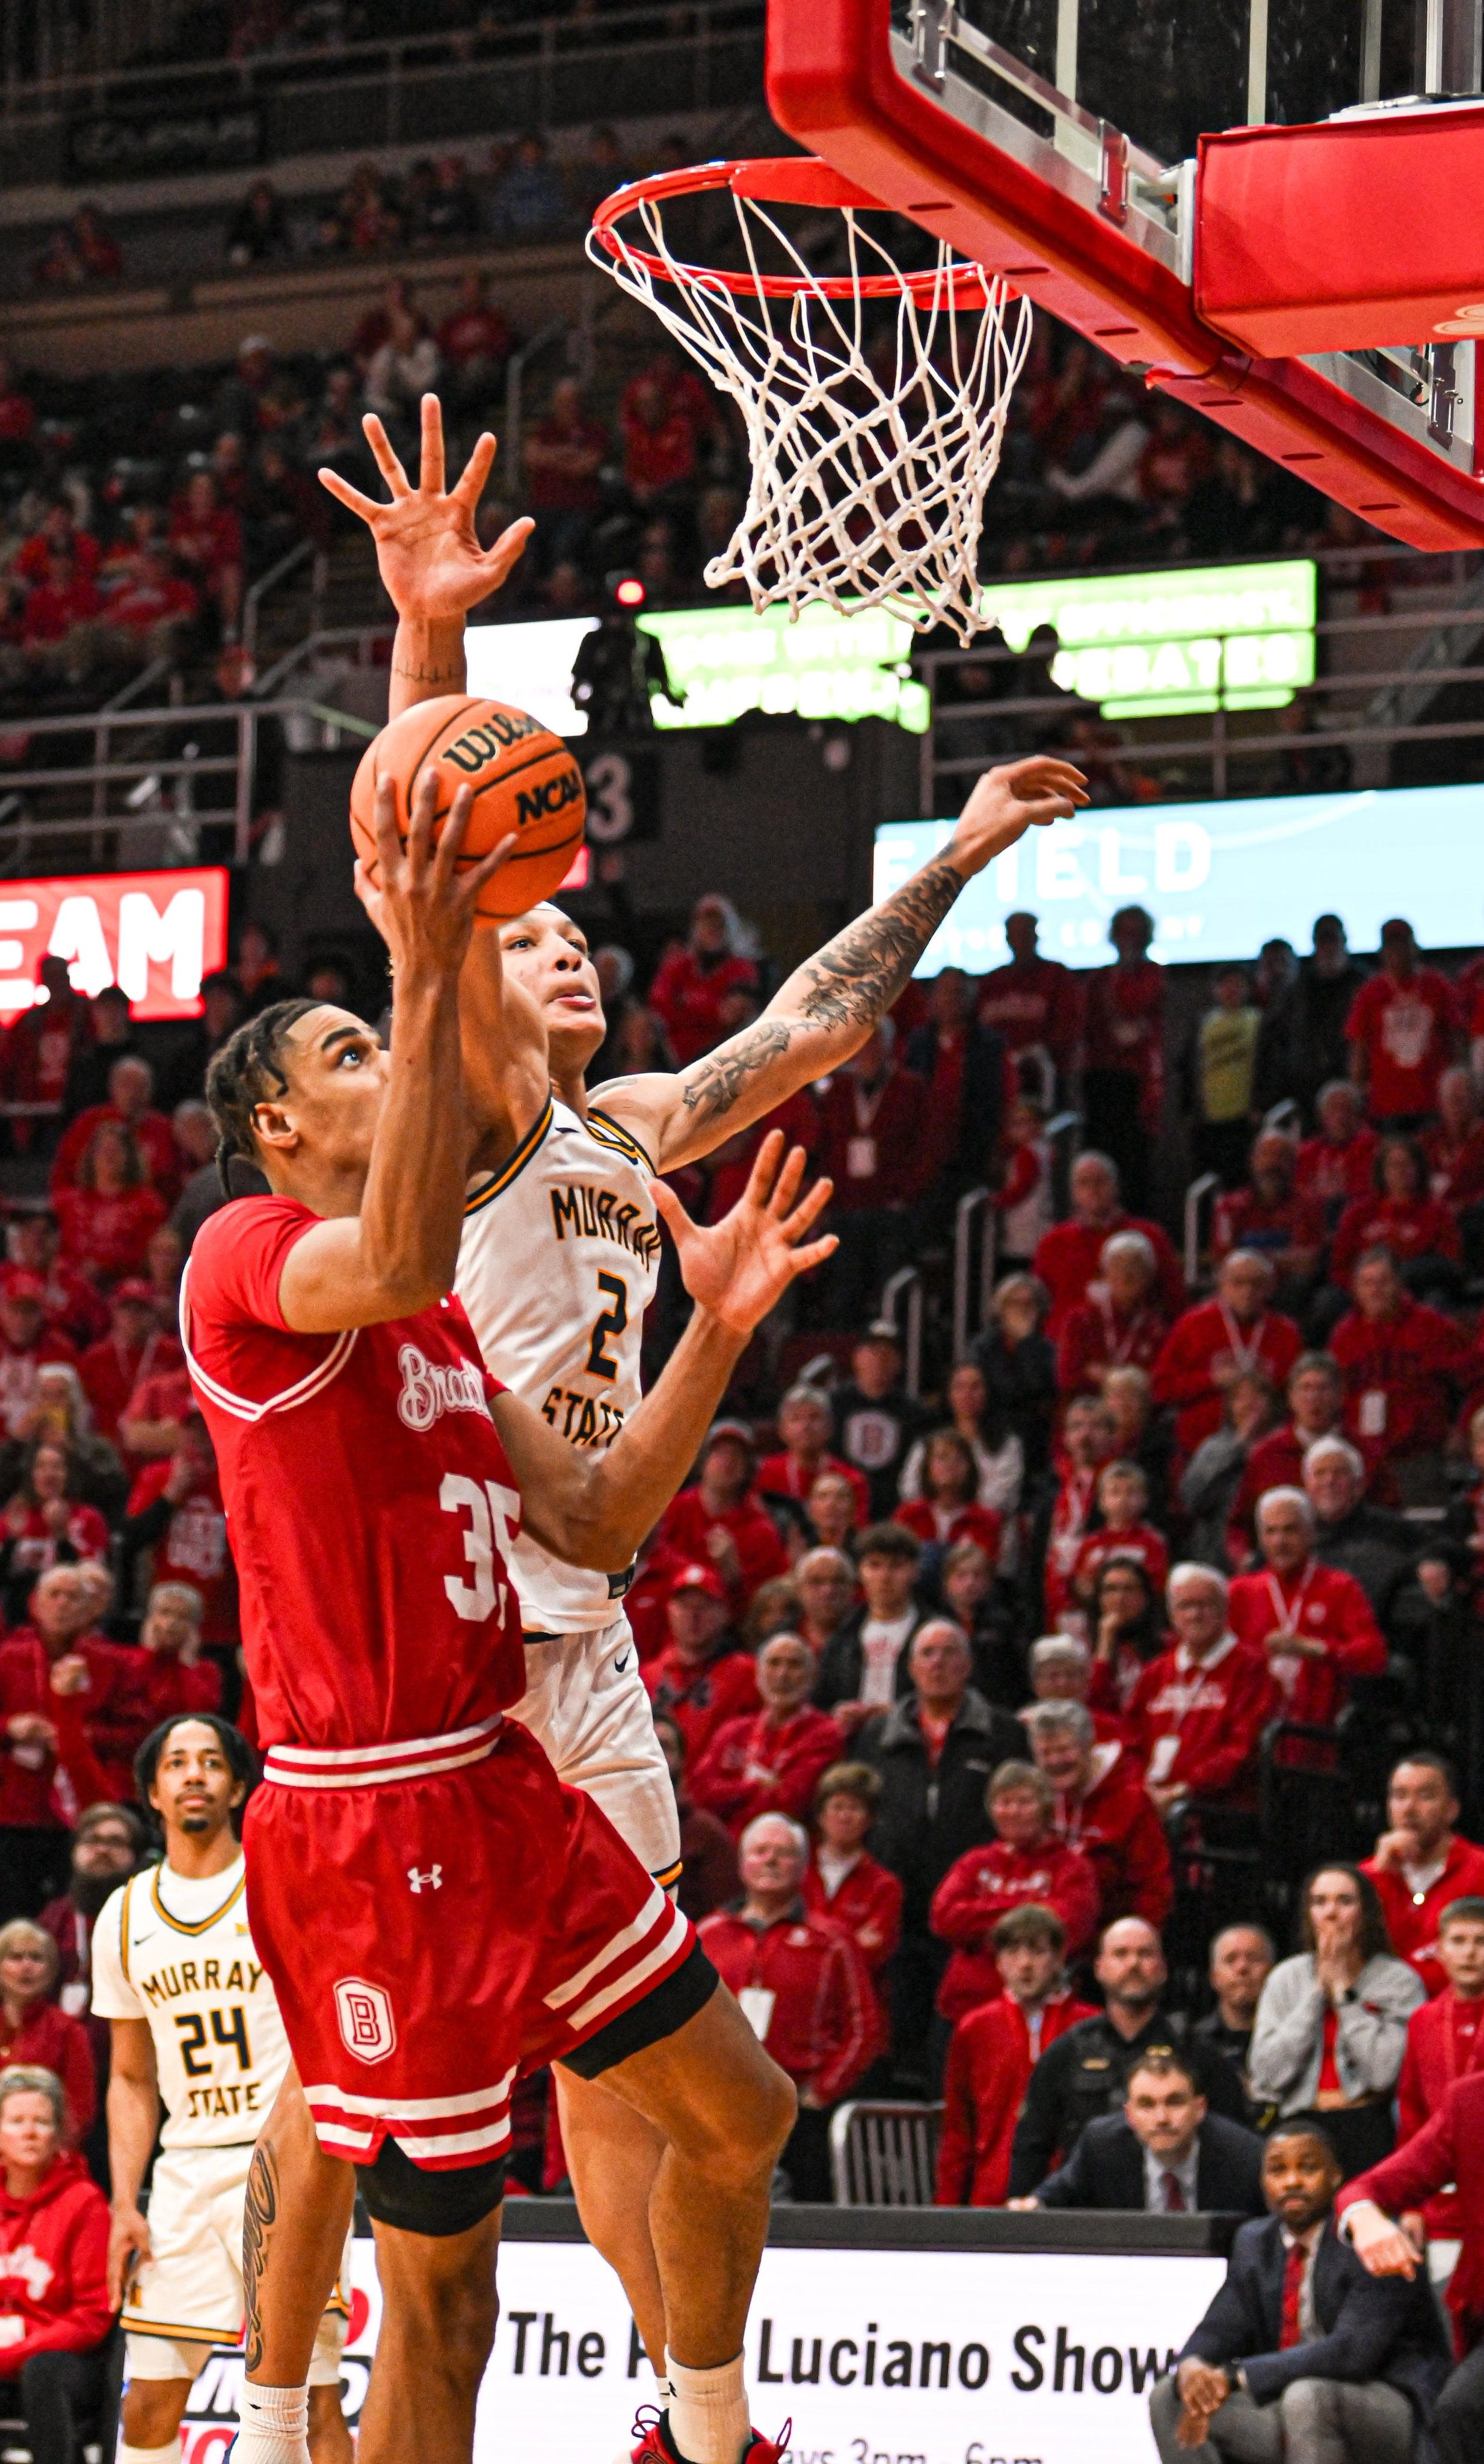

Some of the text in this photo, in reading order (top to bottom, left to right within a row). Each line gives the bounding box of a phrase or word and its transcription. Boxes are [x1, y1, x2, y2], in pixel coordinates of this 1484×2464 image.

[585, 1268, 628, 1383] 2
[397, 1343, 494, 1432] Brad
[141, 1959, 263, 2008] MURRAY
[174, 2005, 251, 2078] 24
[188, 2082, 262, 2118] STATE
[508, 2311, 604, 2377] The
[757, 2319, 990, 2390] Luciano
[1011, 2325, 1177, 2394] Show
